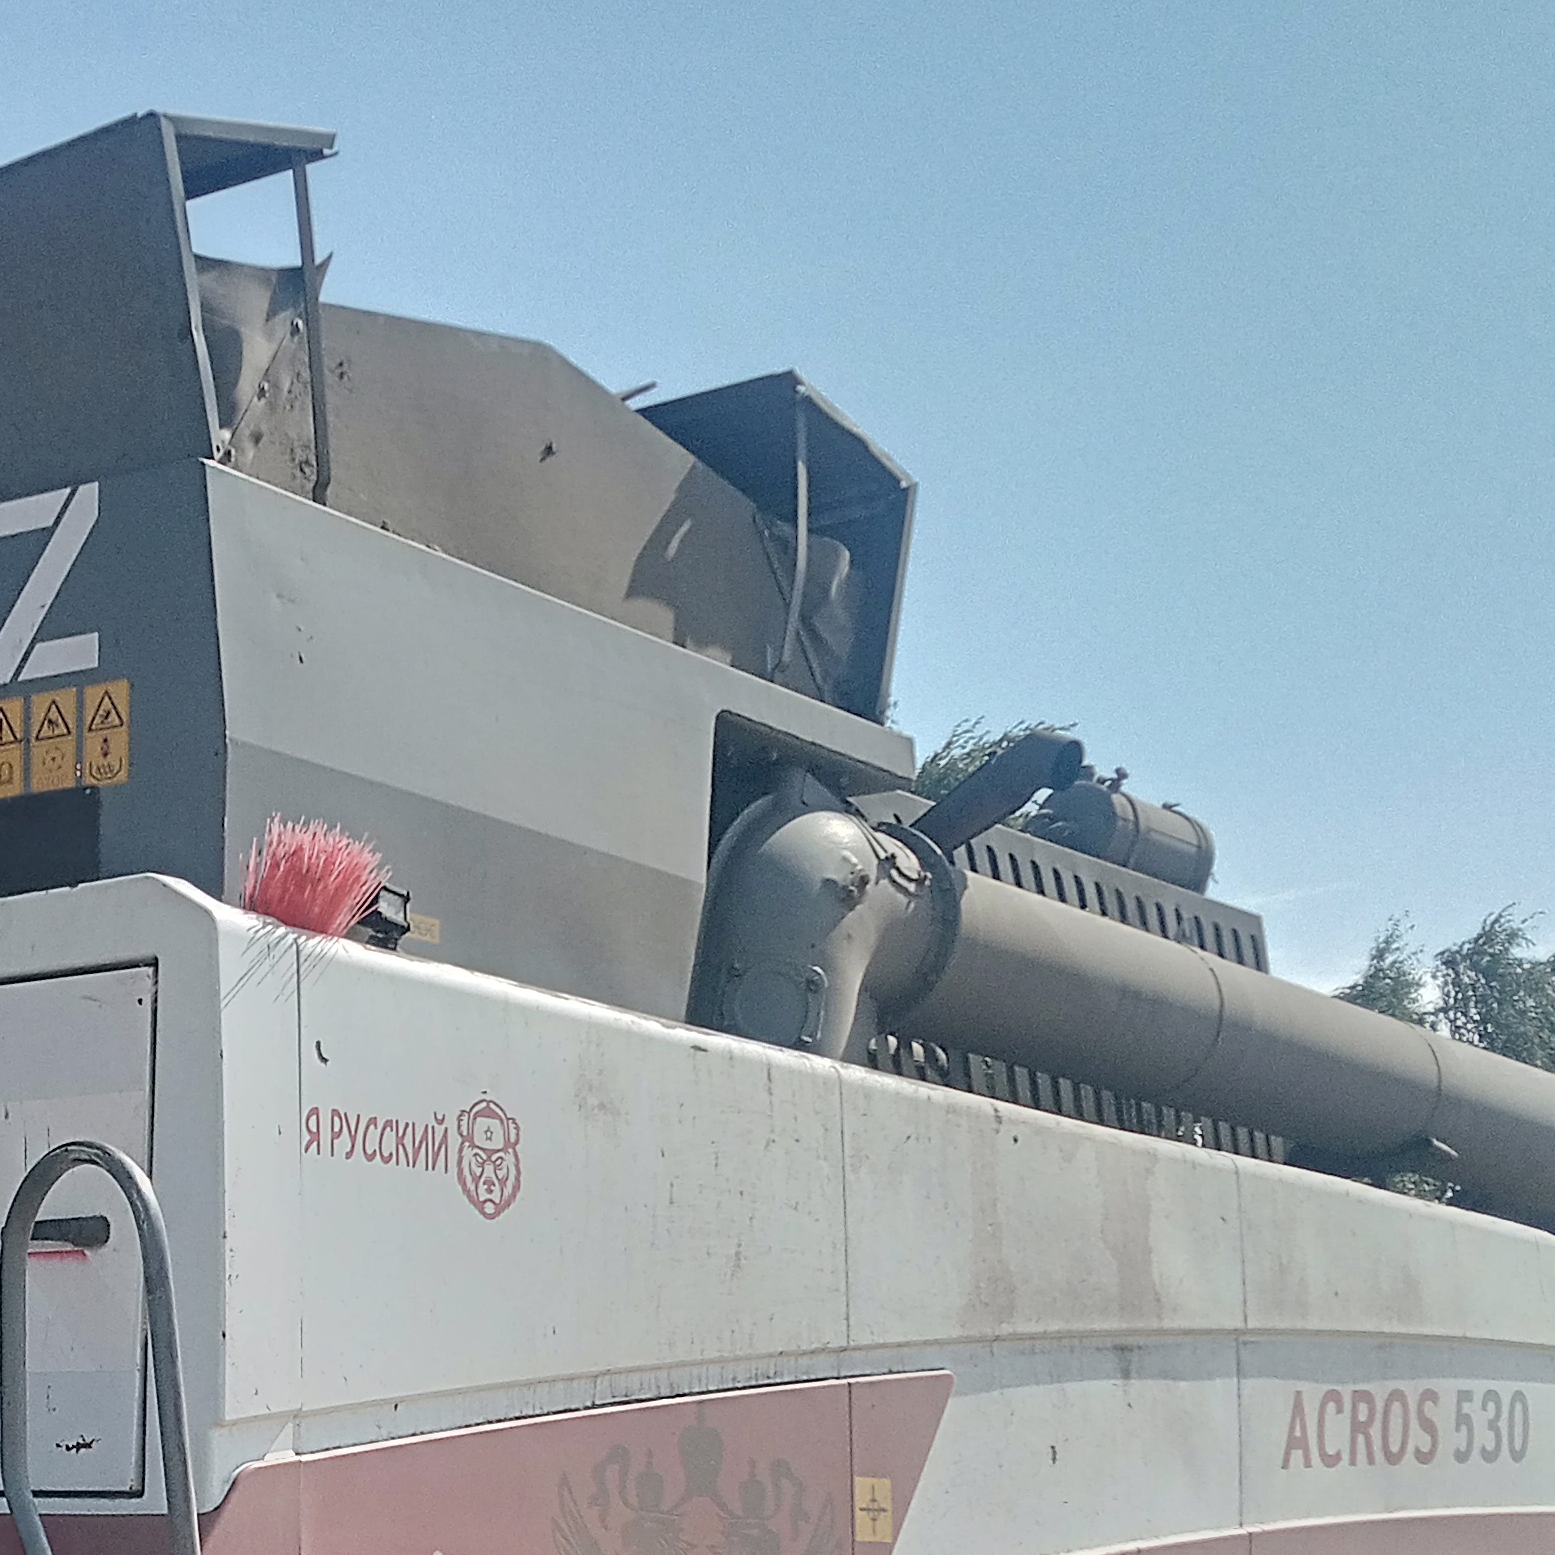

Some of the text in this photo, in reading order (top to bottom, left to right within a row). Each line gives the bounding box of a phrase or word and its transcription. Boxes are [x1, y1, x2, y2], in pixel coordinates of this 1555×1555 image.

[304, 1106, 449, 1175] Я РУССКИЙ
[1280, 1388, 1530, 1470] ACROS 530
